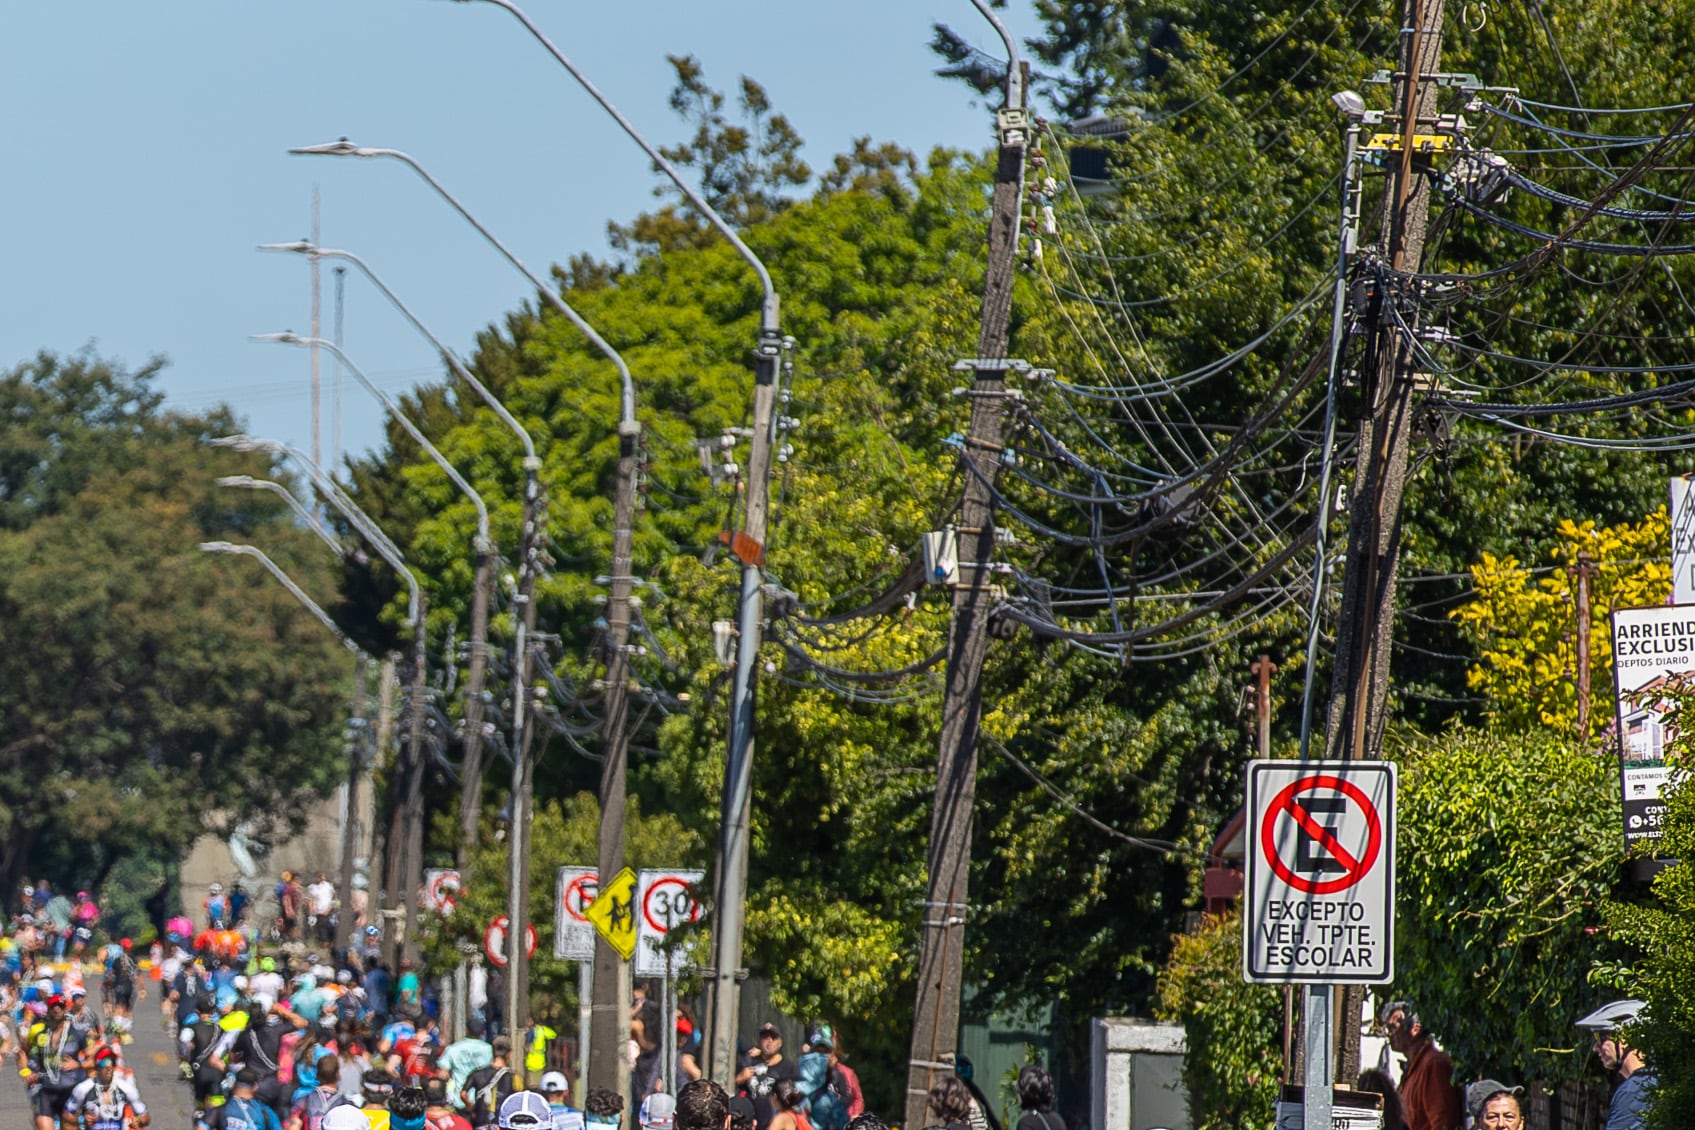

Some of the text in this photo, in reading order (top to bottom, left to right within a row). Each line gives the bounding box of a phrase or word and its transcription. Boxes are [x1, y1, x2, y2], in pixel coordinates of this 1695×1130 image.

[1617, 658, 1654, 668] DEPTOS
[655, 890, 689, 915] 30
[1268, 900, 1364, 921] EXCEPTO
[1262, 923, 1376, 946] VEH. TPTE.
[1266, 946, 1373, 967] ESCOLAR
